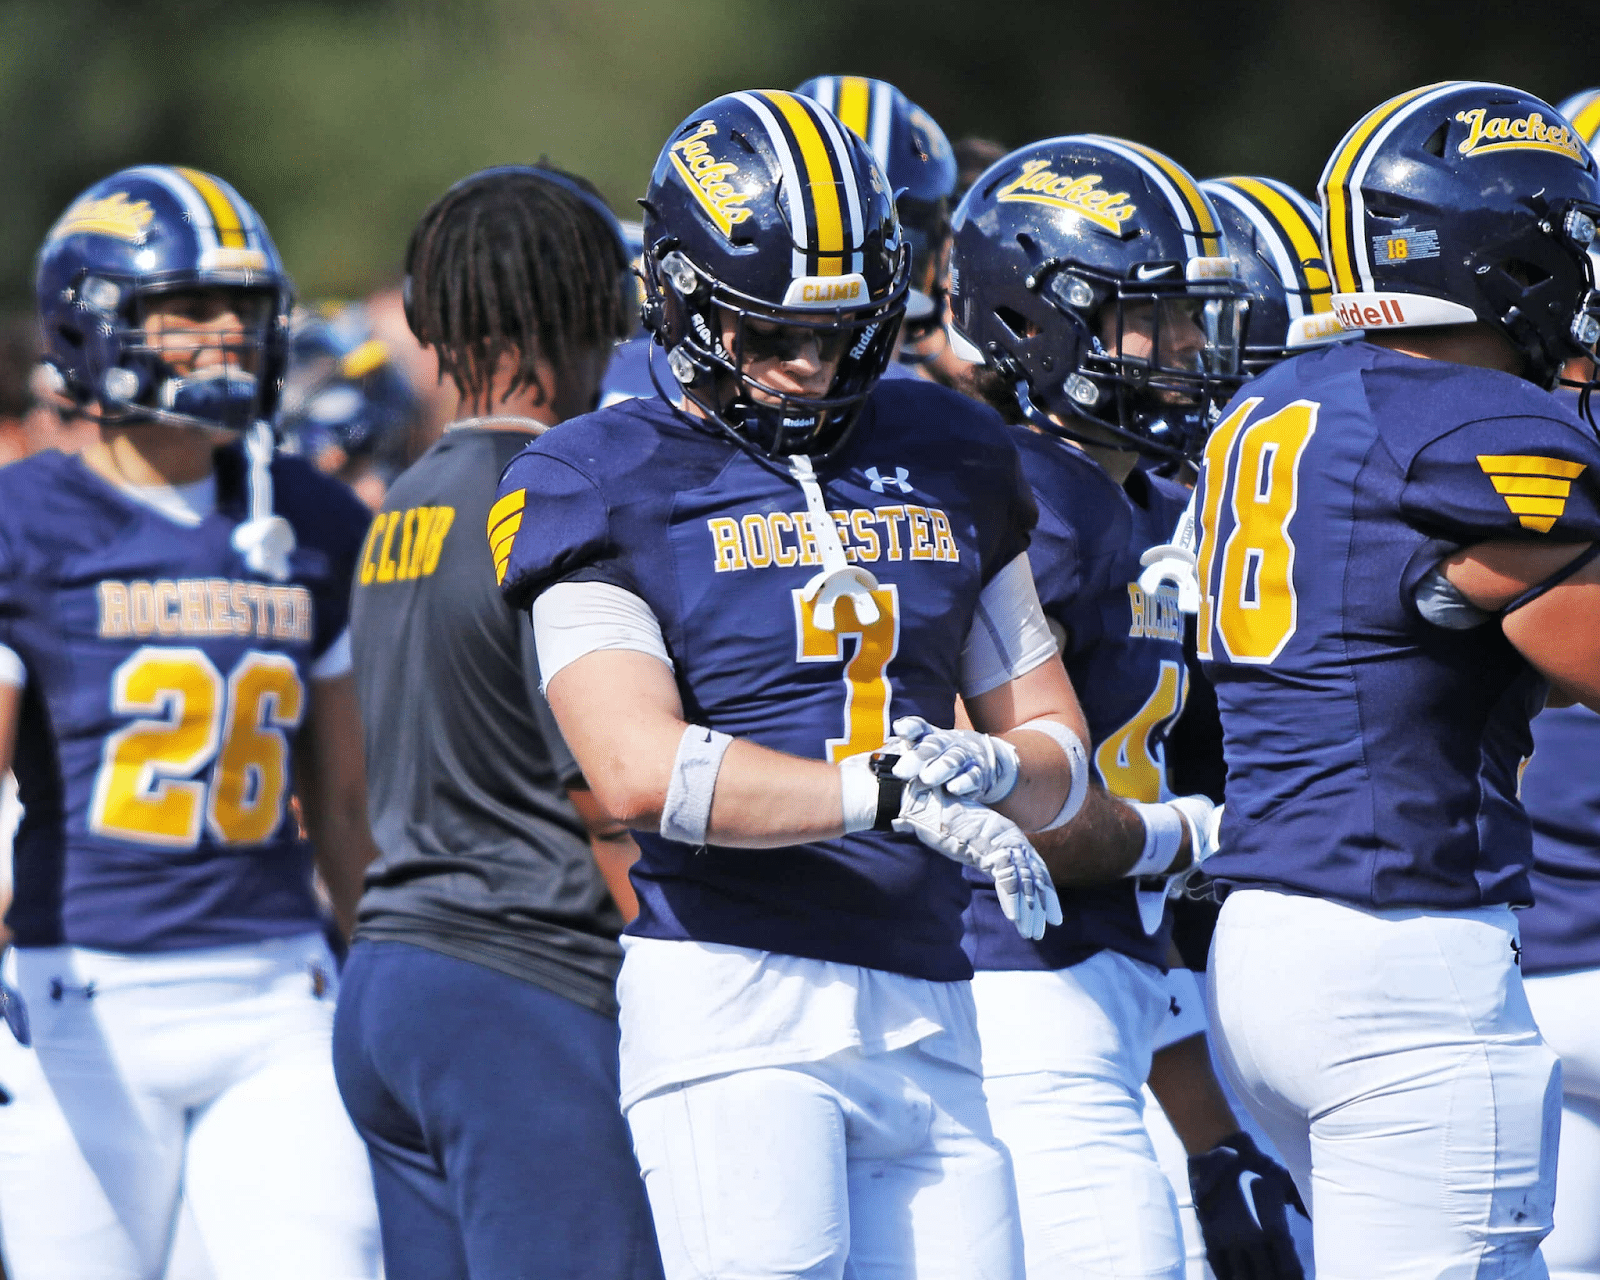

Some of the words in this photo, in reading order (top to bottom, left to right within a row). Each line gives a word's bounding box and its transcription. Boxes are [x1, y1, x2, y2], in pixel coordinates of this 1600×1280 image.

[1386, 238, 1408, 260] 18
[802, 281, 861, 302] CLIMB
[1336, 299, 1405, 327] ddell
[359, 506, 456, 587] CLIMB
[707, 504, 960, 573] ROCHESTER
[1196, 396, 1321, 665] 18
[97, 577, 312, 641] ROCHESTER
[791, 583, 901, 766] 7
[89, 646, 304, 849] 26
[1095, 659, 1190, 803] 4
